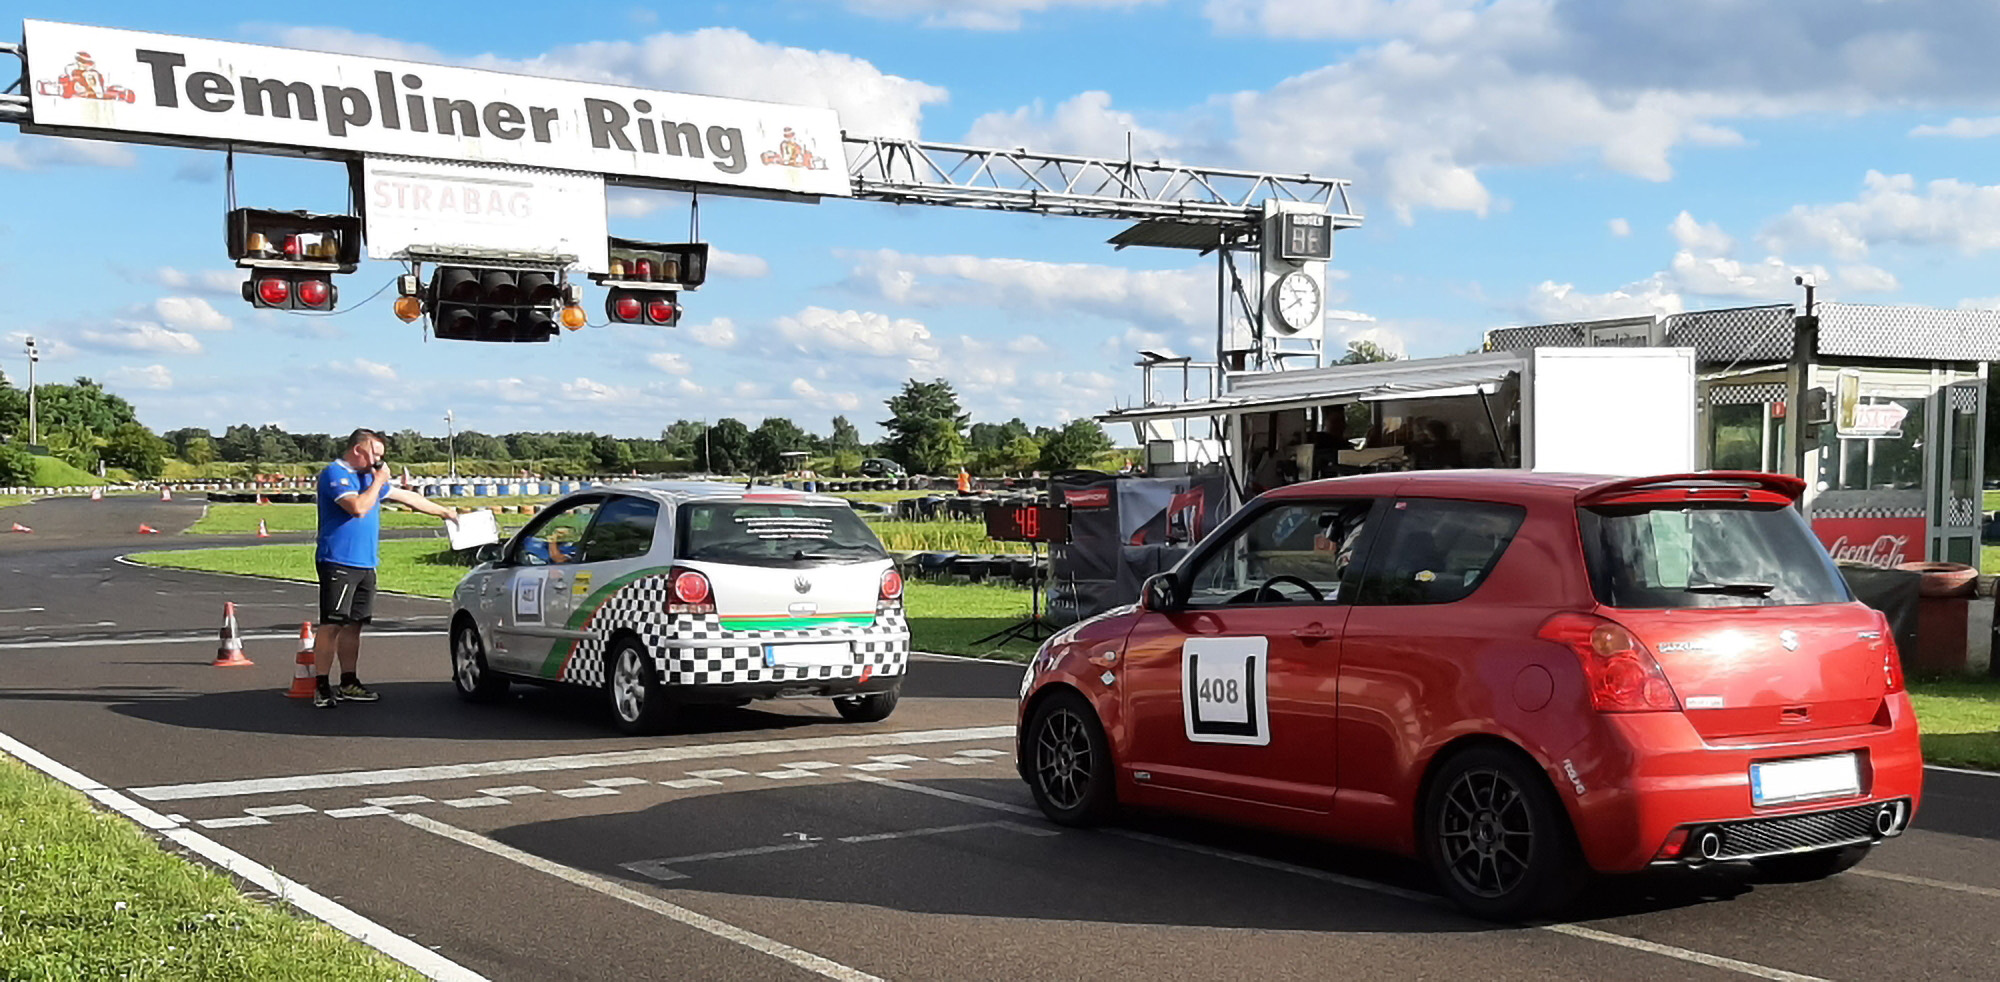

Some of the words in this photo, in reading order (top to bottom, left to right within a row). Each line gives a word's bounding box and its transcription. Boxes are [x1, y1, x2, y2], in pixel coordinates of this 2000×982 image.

[136, 48, 558, 144] Templiner
[584, 98, 747, 174] Ring
[373, 180, 533, 218] STRABAG
[1015, 506, 1038, 538] 48
[1200, 678, 1239, 704] 408
